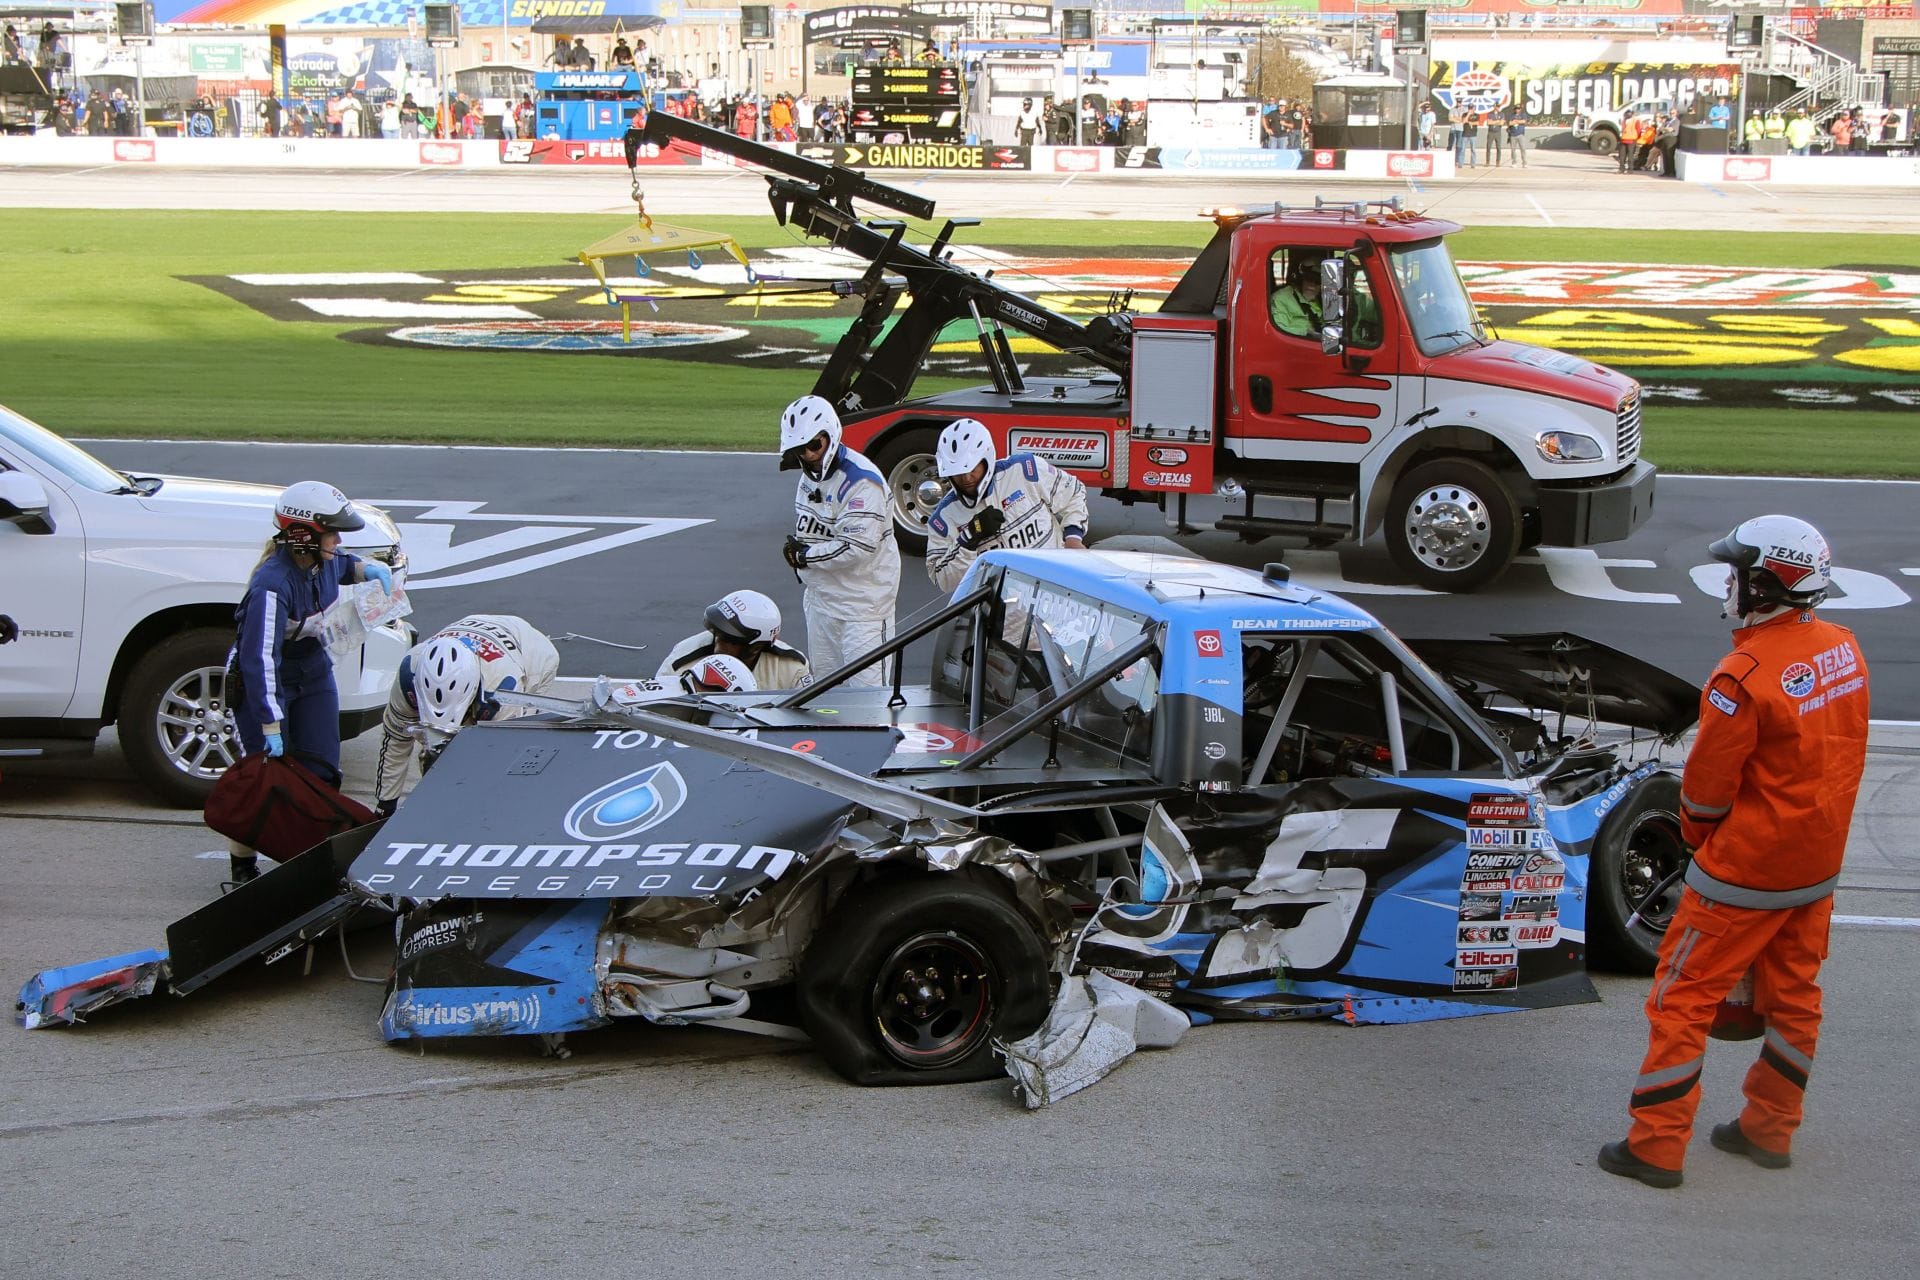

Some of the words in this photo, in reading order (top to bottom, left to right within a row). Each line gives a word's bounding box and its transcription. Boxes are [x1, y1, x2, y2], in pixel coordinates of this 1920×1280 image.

[511, 1, 606, 17] SUNOCO
[287, 58, 336, 70] totrader
[291, 73, 342, 87] EchoPark
[558, 75, 611, 86] HALMAR
[1526, 79, 1611, 116] SPEED
[503, 142, 534, 162] 52
[867, 146, 983, 168] GAINBRIDGE
[1125, 147, 1148, 167] 5
[1017, 435, 1099, 452] PREMIER
[1056, 453, 1092, 462] GROUP
[1160, 472, 1192, 484] TEXAS
[282, 506, 311, 519] TEXAS
[797, 515, 835, 539] CIAL
[1769, 545, 1813, 565] TEXAS
[1231, 619, 1278, 629] DEAN
[1282, 619, 1373, 629] THOMPSON
[20, 630, 73, 638] AHOE
[1813, 641, 1855, 676] TEXAS
[711, 659, 737, 682] TEXAS
[1799, 692, 1826, 717] FIRE
[1827, 676, 1864, 702] RESCUE
[1204, 707, 1225, 723] JBL
[1200, 781, 1221, 791] Mobil
[1470, 805, 1526, 816] CRAFTSMAN
[1470, 829, 1509, 845] Mobil
[384, 842, 799, 881] THOMPSON
[1468, 854, 1525, 867] COMETIC
[1465, 871, 1505, 882] LINCOLN
[1514, 875, 1564, 890] CALICO
[1205, 809, 1400, 978] 5
[1472, 881, 1507, 890] WELDERS
[1459, 926, 1509, 942] KOOKS
[413, 931, 457, 954] EXPRESS
[1460, 951, 1514, 966] tilton
[1455, 970, 1492, 988] Holley
